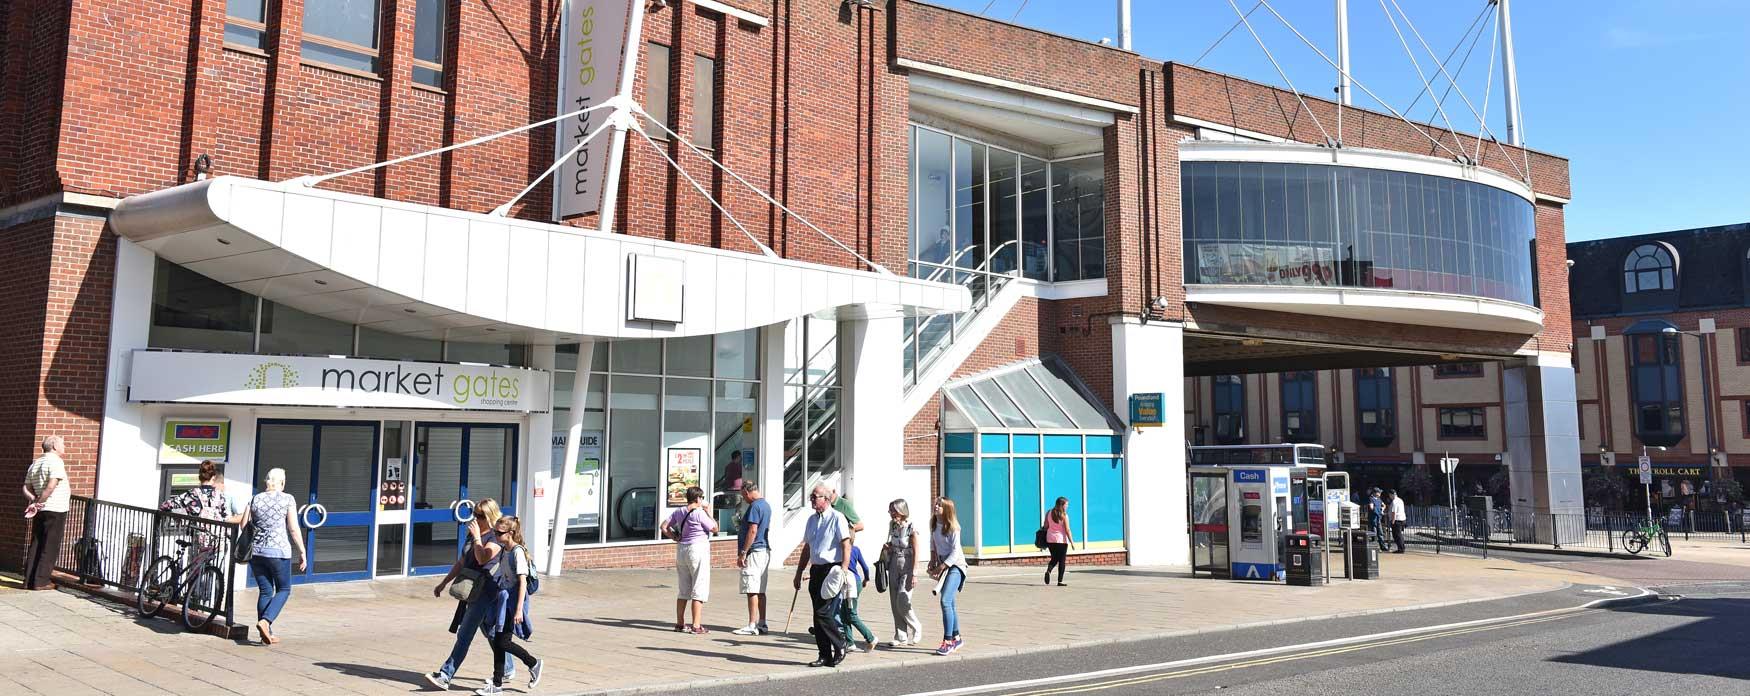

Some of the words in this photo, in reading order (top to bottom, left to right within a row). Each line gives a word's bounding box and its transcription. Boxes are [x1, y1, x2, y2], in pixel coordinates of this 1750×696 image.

[577, 6, 595, 85] gates
[574, 96, 591, 195] market
[321, 364, 444, 395] market
[453, 370, 519, 404] gates
[480, 398, 504, 407] shopping
[579, 436, 598, 446] UIDE
[199, 444, 224, 453] HERE
[1240, 471, 1260, 480] Cash
[1628, 467, 1640, 475] TH
[1651, 467, 1675, 475] ROLL
[1677, 467, 1701, 475] CART
